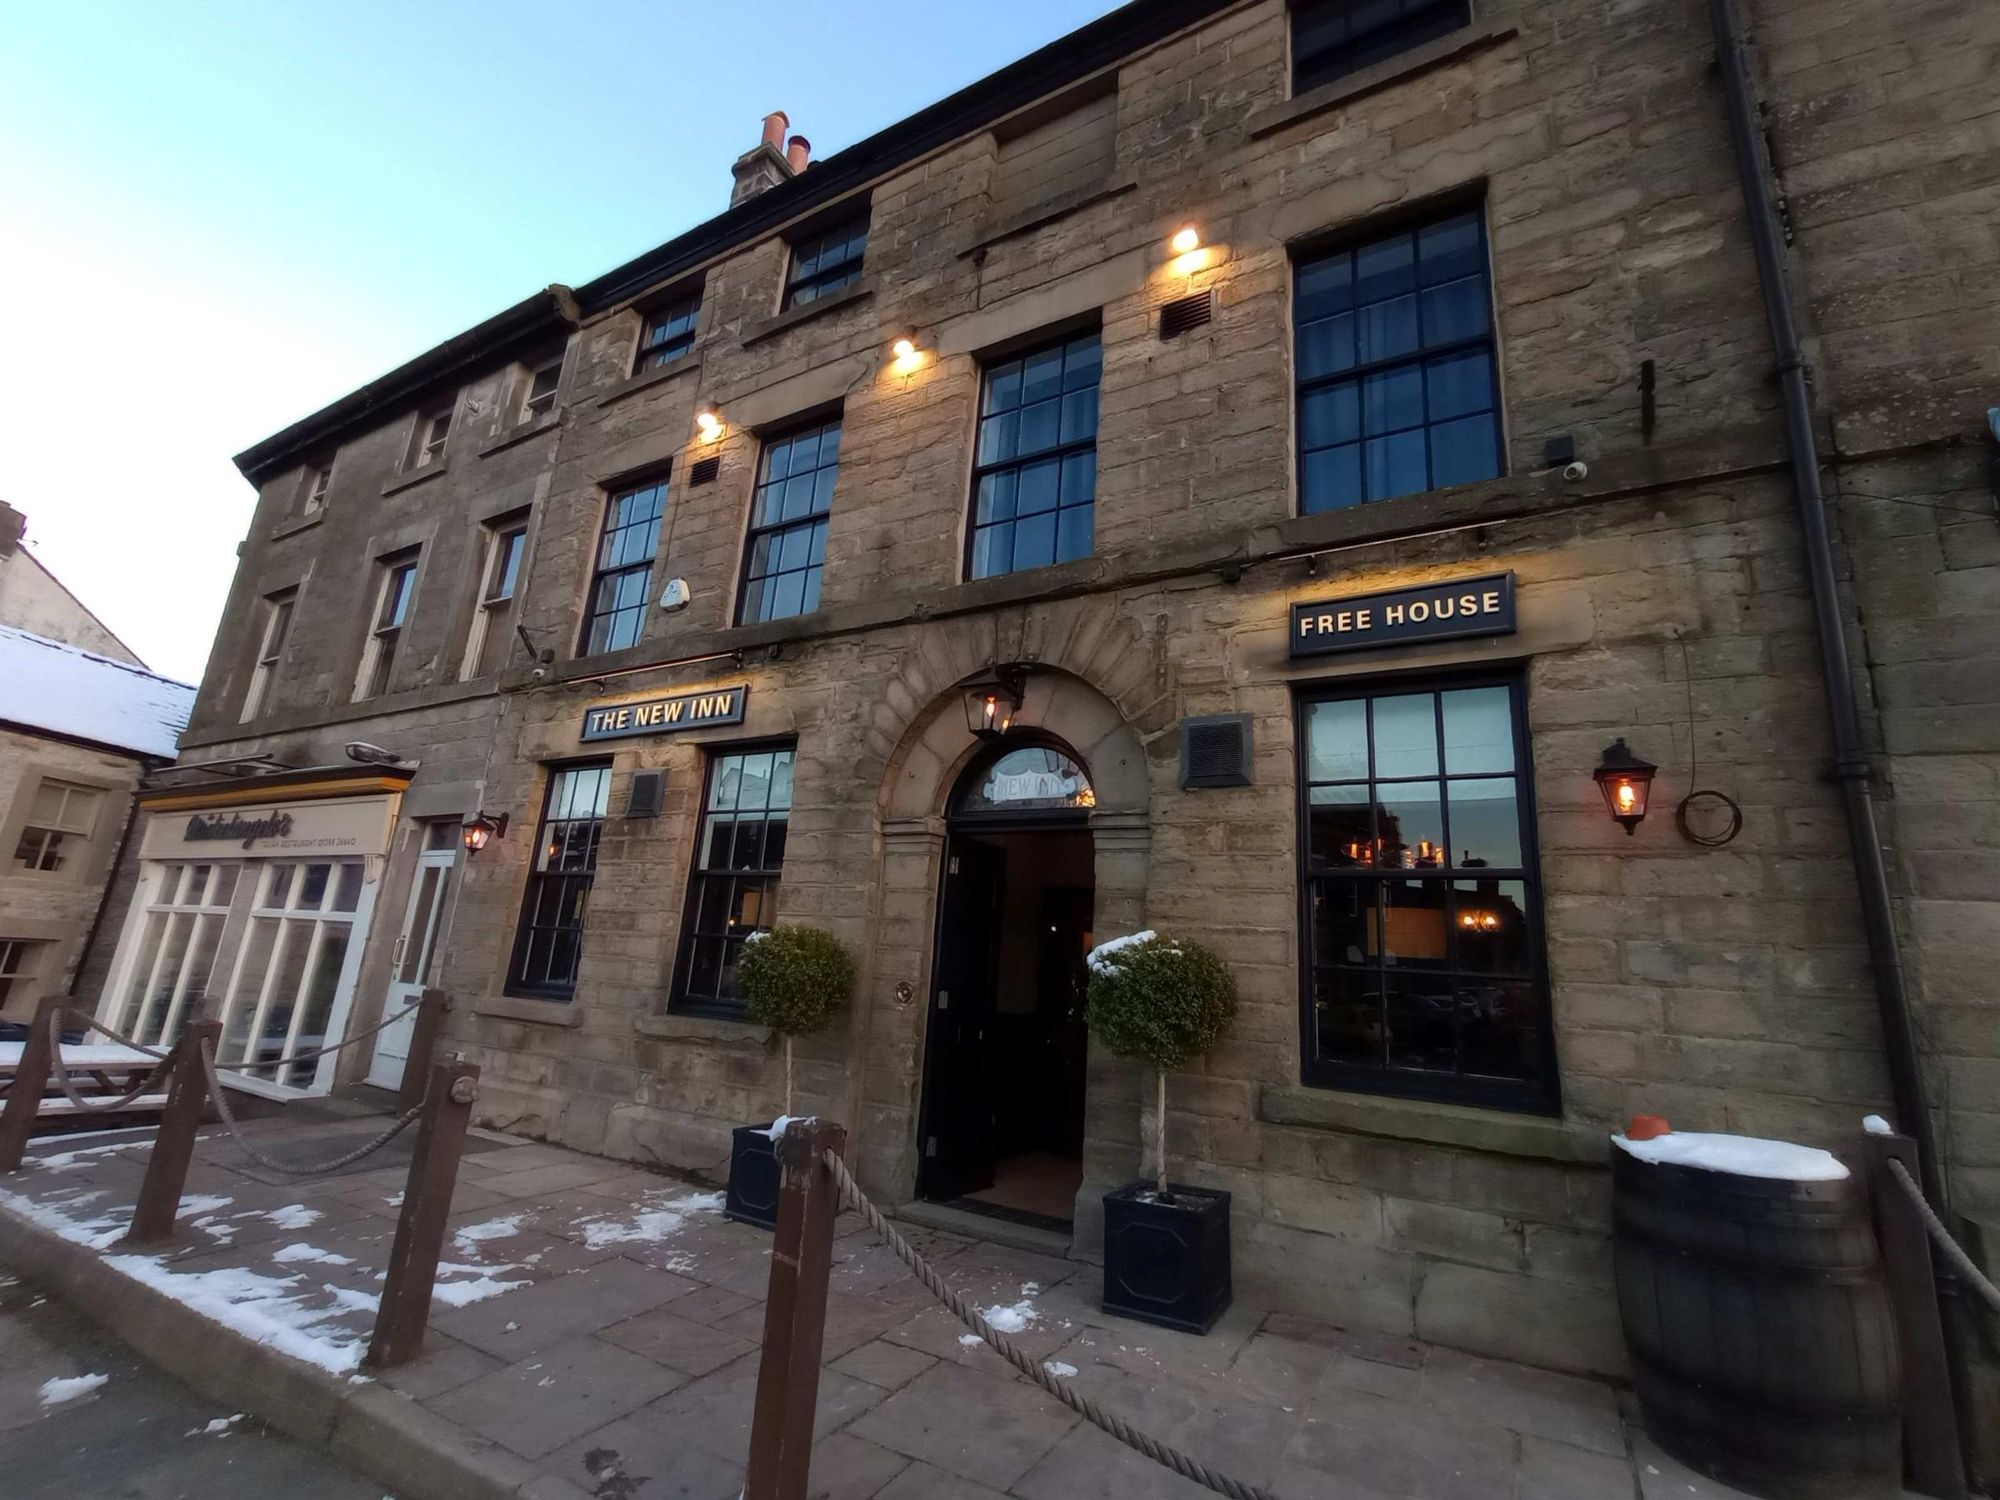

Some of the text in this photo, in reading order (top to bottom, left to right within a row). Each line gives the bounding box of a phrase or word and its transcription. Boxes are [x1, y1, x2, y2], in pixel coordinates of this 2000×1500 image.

[1300, 591, 1500, 637] FREE HOUSE
[593, 694, 731, 732] THE NEW INN
